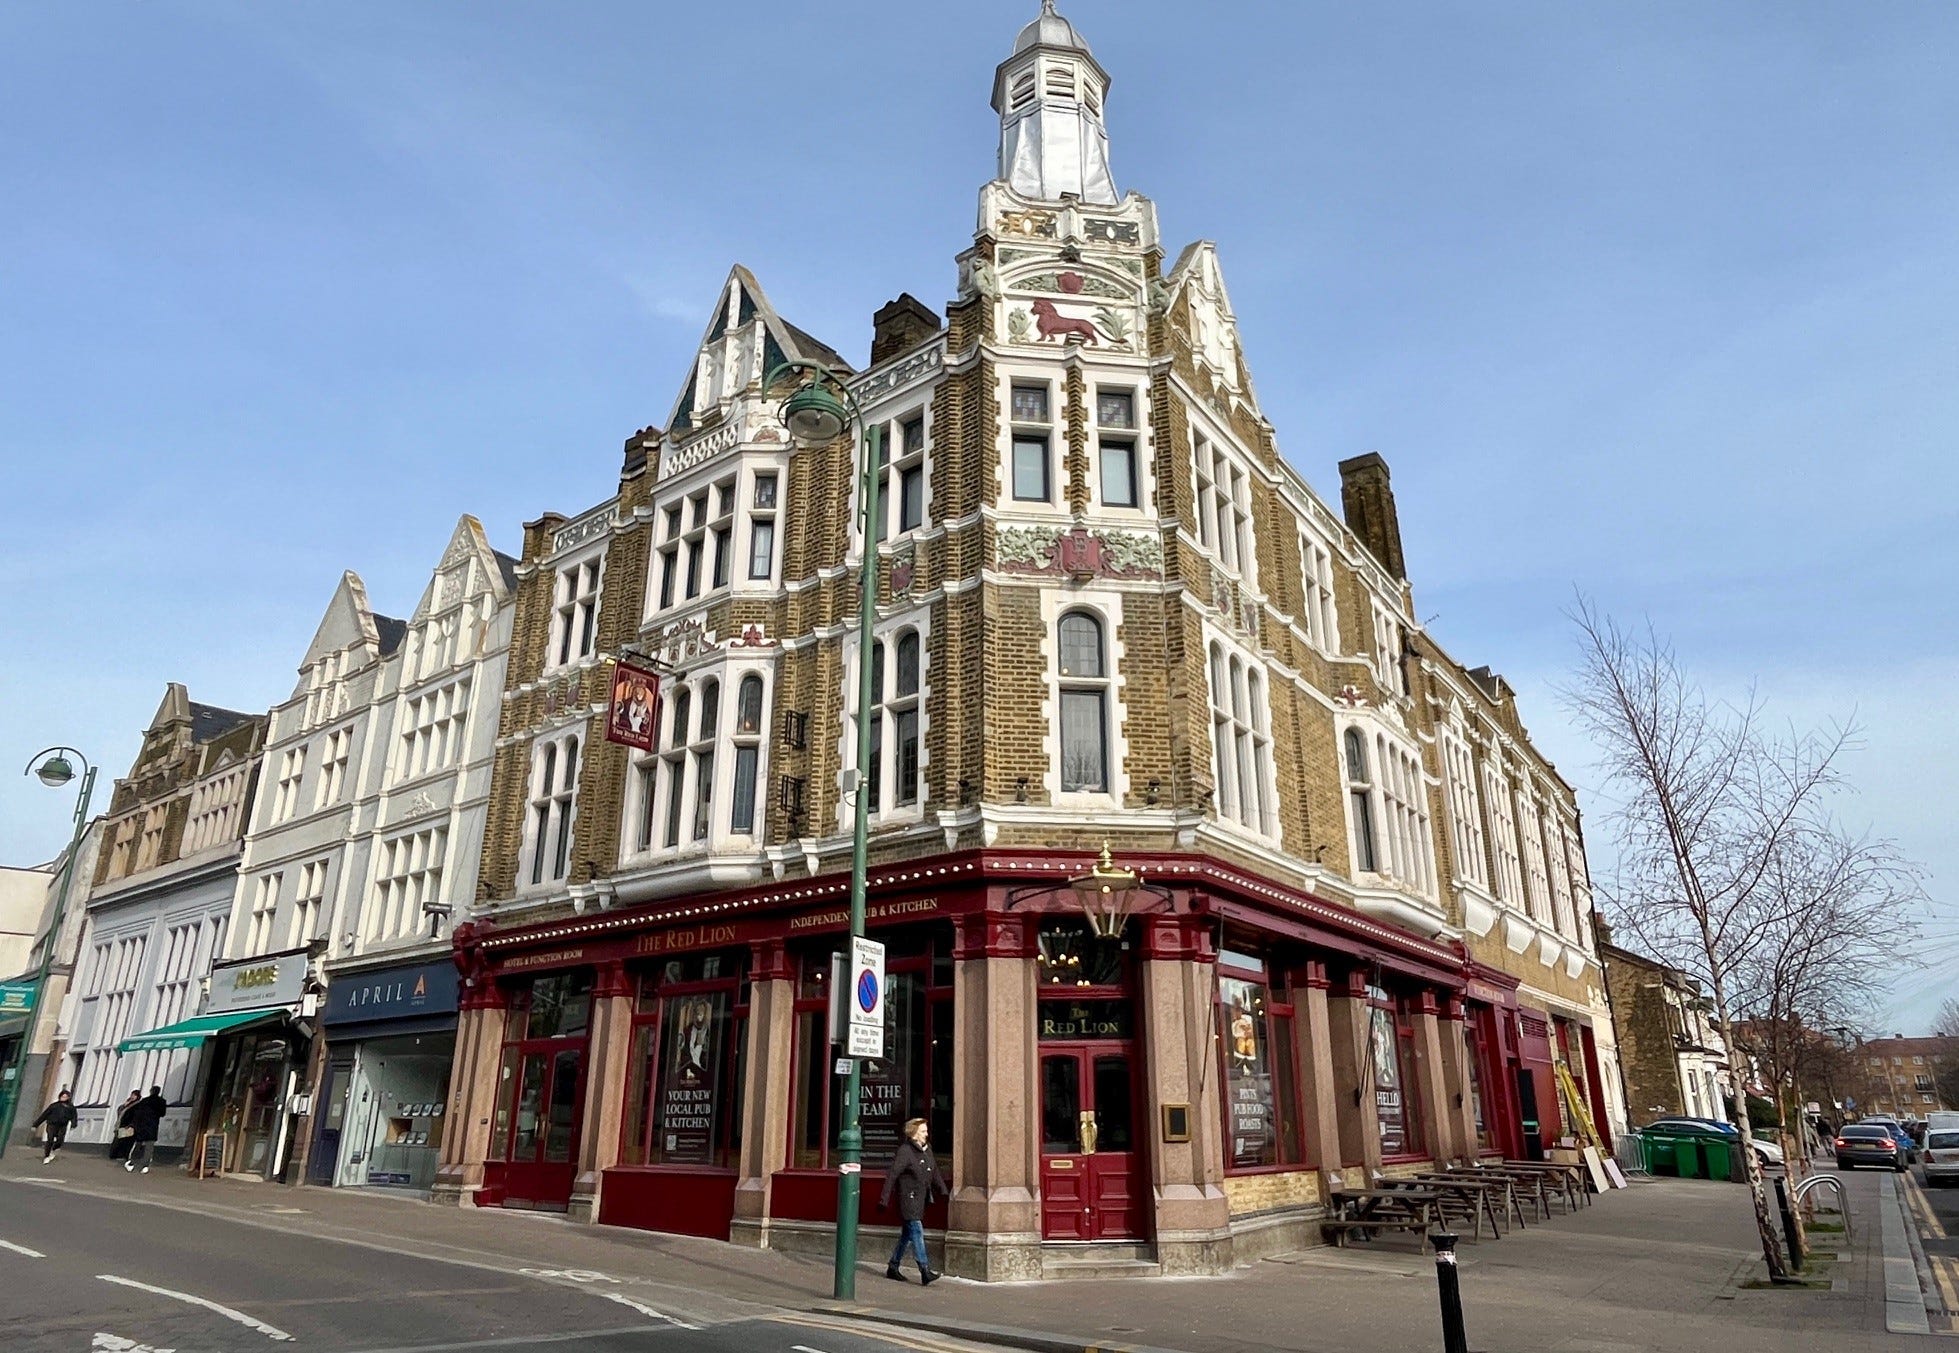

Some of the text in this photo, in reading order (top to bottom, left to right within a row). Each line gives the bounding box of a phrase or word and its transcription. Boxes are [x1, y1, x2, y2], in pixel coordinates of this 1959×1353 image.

[791, 910, 850, 929] INDEPENDEN
[879, 904, 886, 916] &
[889, 898, 938, 915] KITCHEN
[636, 925, 737, 953] THE RED LION
[855, 940, 883, 956] Restricted
[503, 957, 523, 968] HOTEL
[530, 952, 562, 965] FUNCTION
[563, 949, 583, 960] ROOM
[861, 953, 877, 967] Zone
[348, 982, 403, 1007] APRIL
[1044, 1019, 1119, 1034] RED LION
[668, 1090, 711, 1101] YOUR NEW
[876, 1085, 902, 1098] THE
[1376, 1091, 1399, 1106] HELLO
[666, 1103, 711, 1115] LOCAL PUB
[1234, 1103, 1264, 1115] PUB FOOD
[664, 1117, 710, 1128] & KITCHEN
[1239, 1118, 1261, 1130] ROASTS
